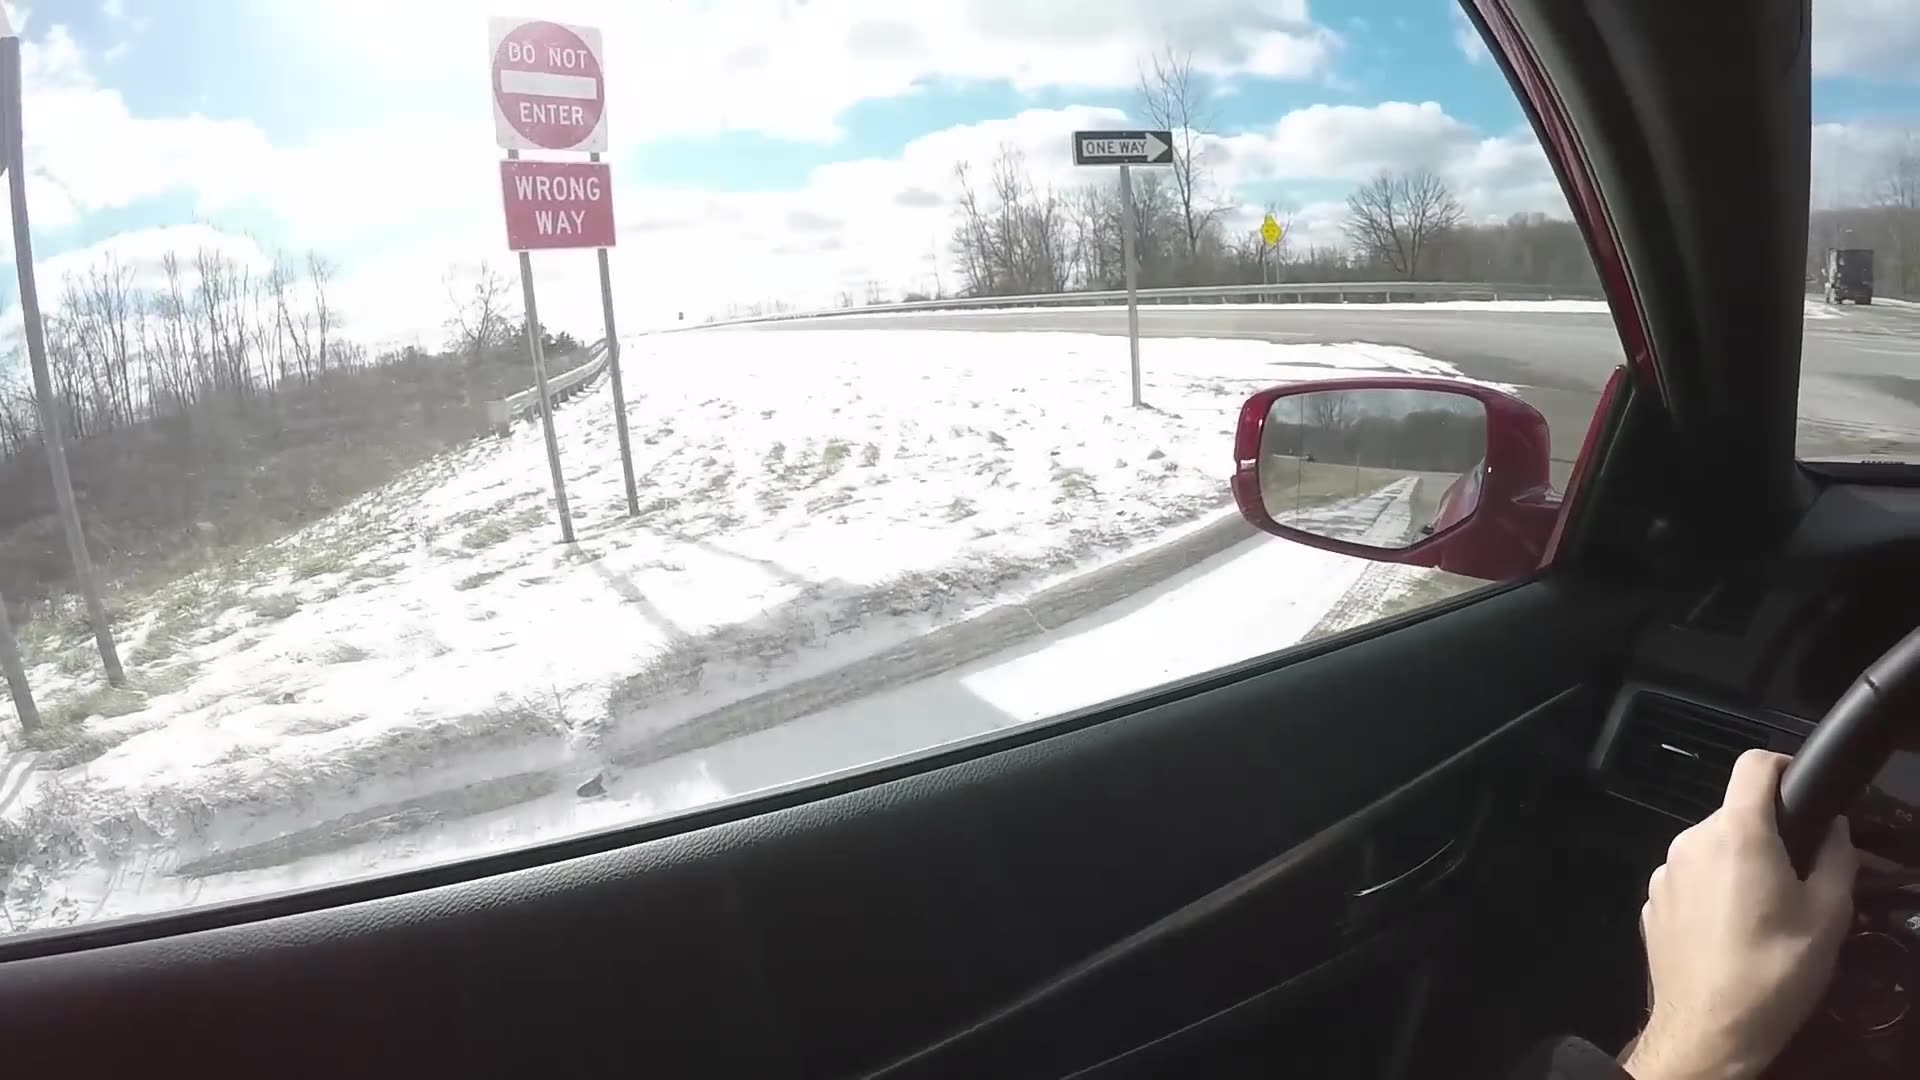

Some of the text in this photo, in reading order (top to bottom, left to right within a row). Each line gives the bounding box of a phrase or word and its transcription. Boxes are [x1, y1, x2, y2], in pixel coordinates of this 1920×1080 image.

[508, 42, 588, 69] DO NOT
[519, 102, 584, 126] ENTER
[1086, 141, 1147, 154] ONE WAY
[515, 175, 601, 201] WRONG
[535, 210, 586, 235] WAY
